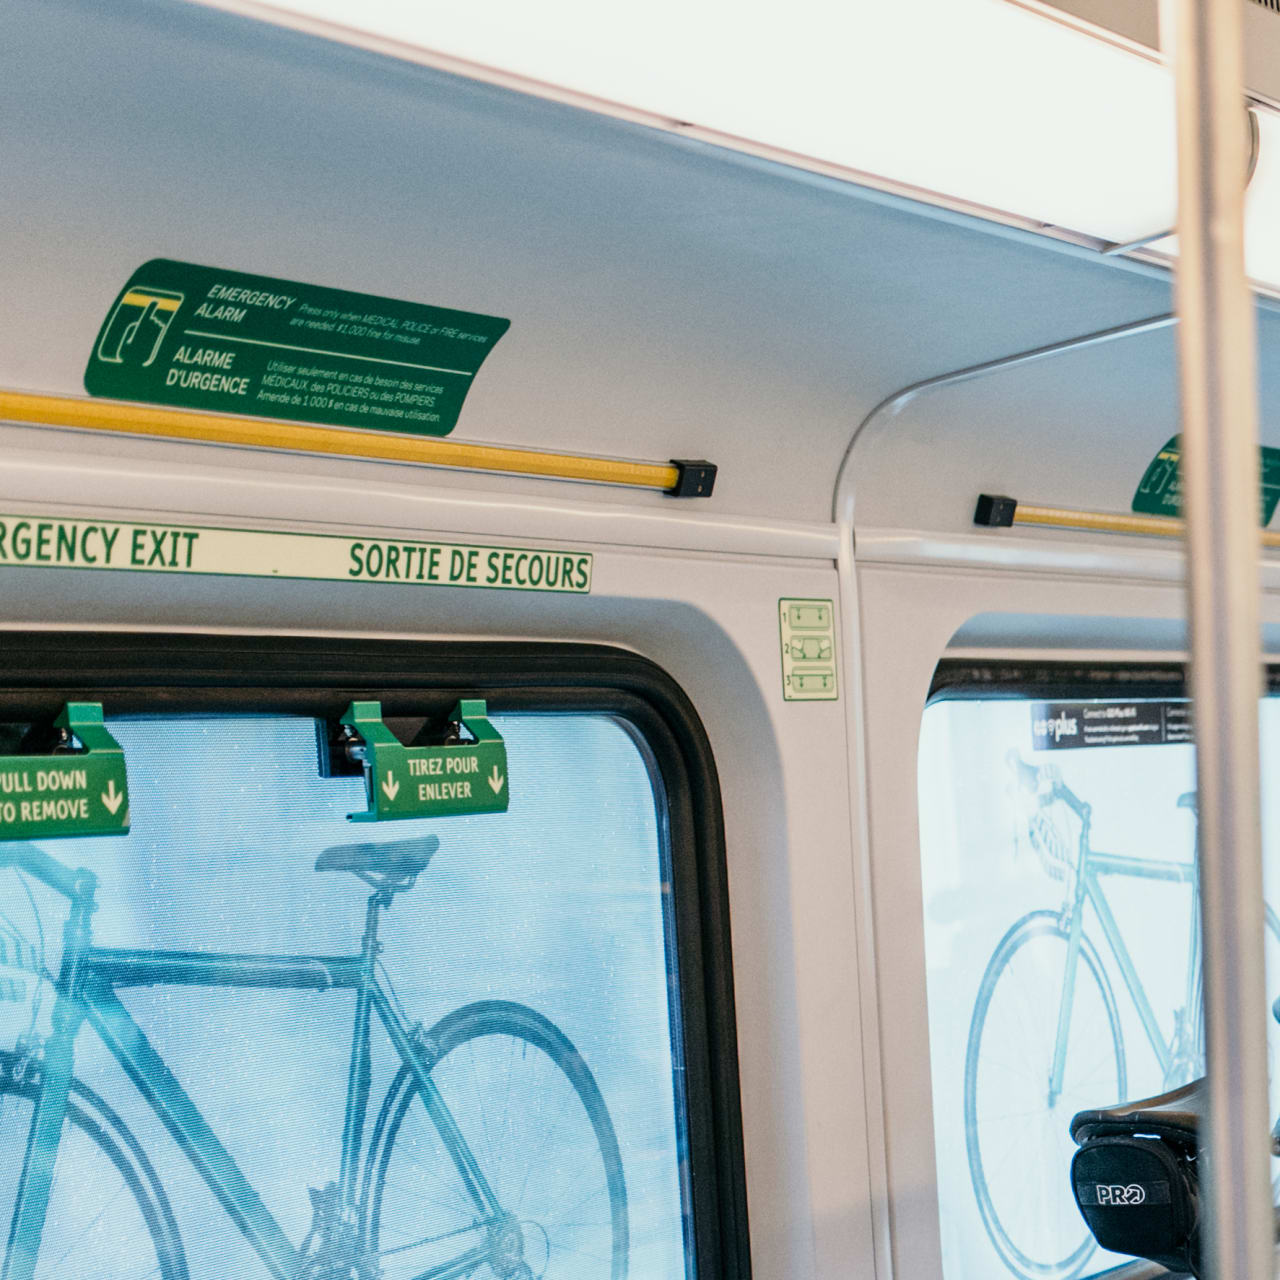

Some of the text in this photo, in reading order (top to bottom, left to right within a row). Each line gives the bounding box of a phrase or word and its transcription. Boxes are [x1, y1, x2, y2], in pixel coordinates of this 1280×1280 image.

[207, 284, 297, 309] EMERGENCY
[194, 302, 247, 323] ALARM
[173, 346, 236, 369] ALARME
[166, 368, 250, 395] D'URGENCE
[267, 360, 297, 373] Utiliser
[297, 366, 338, 380] seulement
[338, 372, 349, 380] en
[349, 374, 363, 383] cas
[363, 373, 374, 384] de
[374, 376, 399, 388] besoin
[310, 382, 325, 393] des
[257, 389, 290, 403] Amende
[291, 394, 302, 405] de
[333, 402, 344, 410] en
[344, 402, 359, 412] cas
[359, 402, 369, 413] de
[131, 529, 199, 568] EXIT
[349, 542, 589, 589] SORTIE DE SECOURS
[407, 756, 479, 776] TIREZ POUR
[0, 769, 87, 793] ULL DOWN
[418, 781, 472, 801] ENLEVER
[21, 798, 89, 822] REMOVE
[1096, 1184, 1145, 1205] PRO
